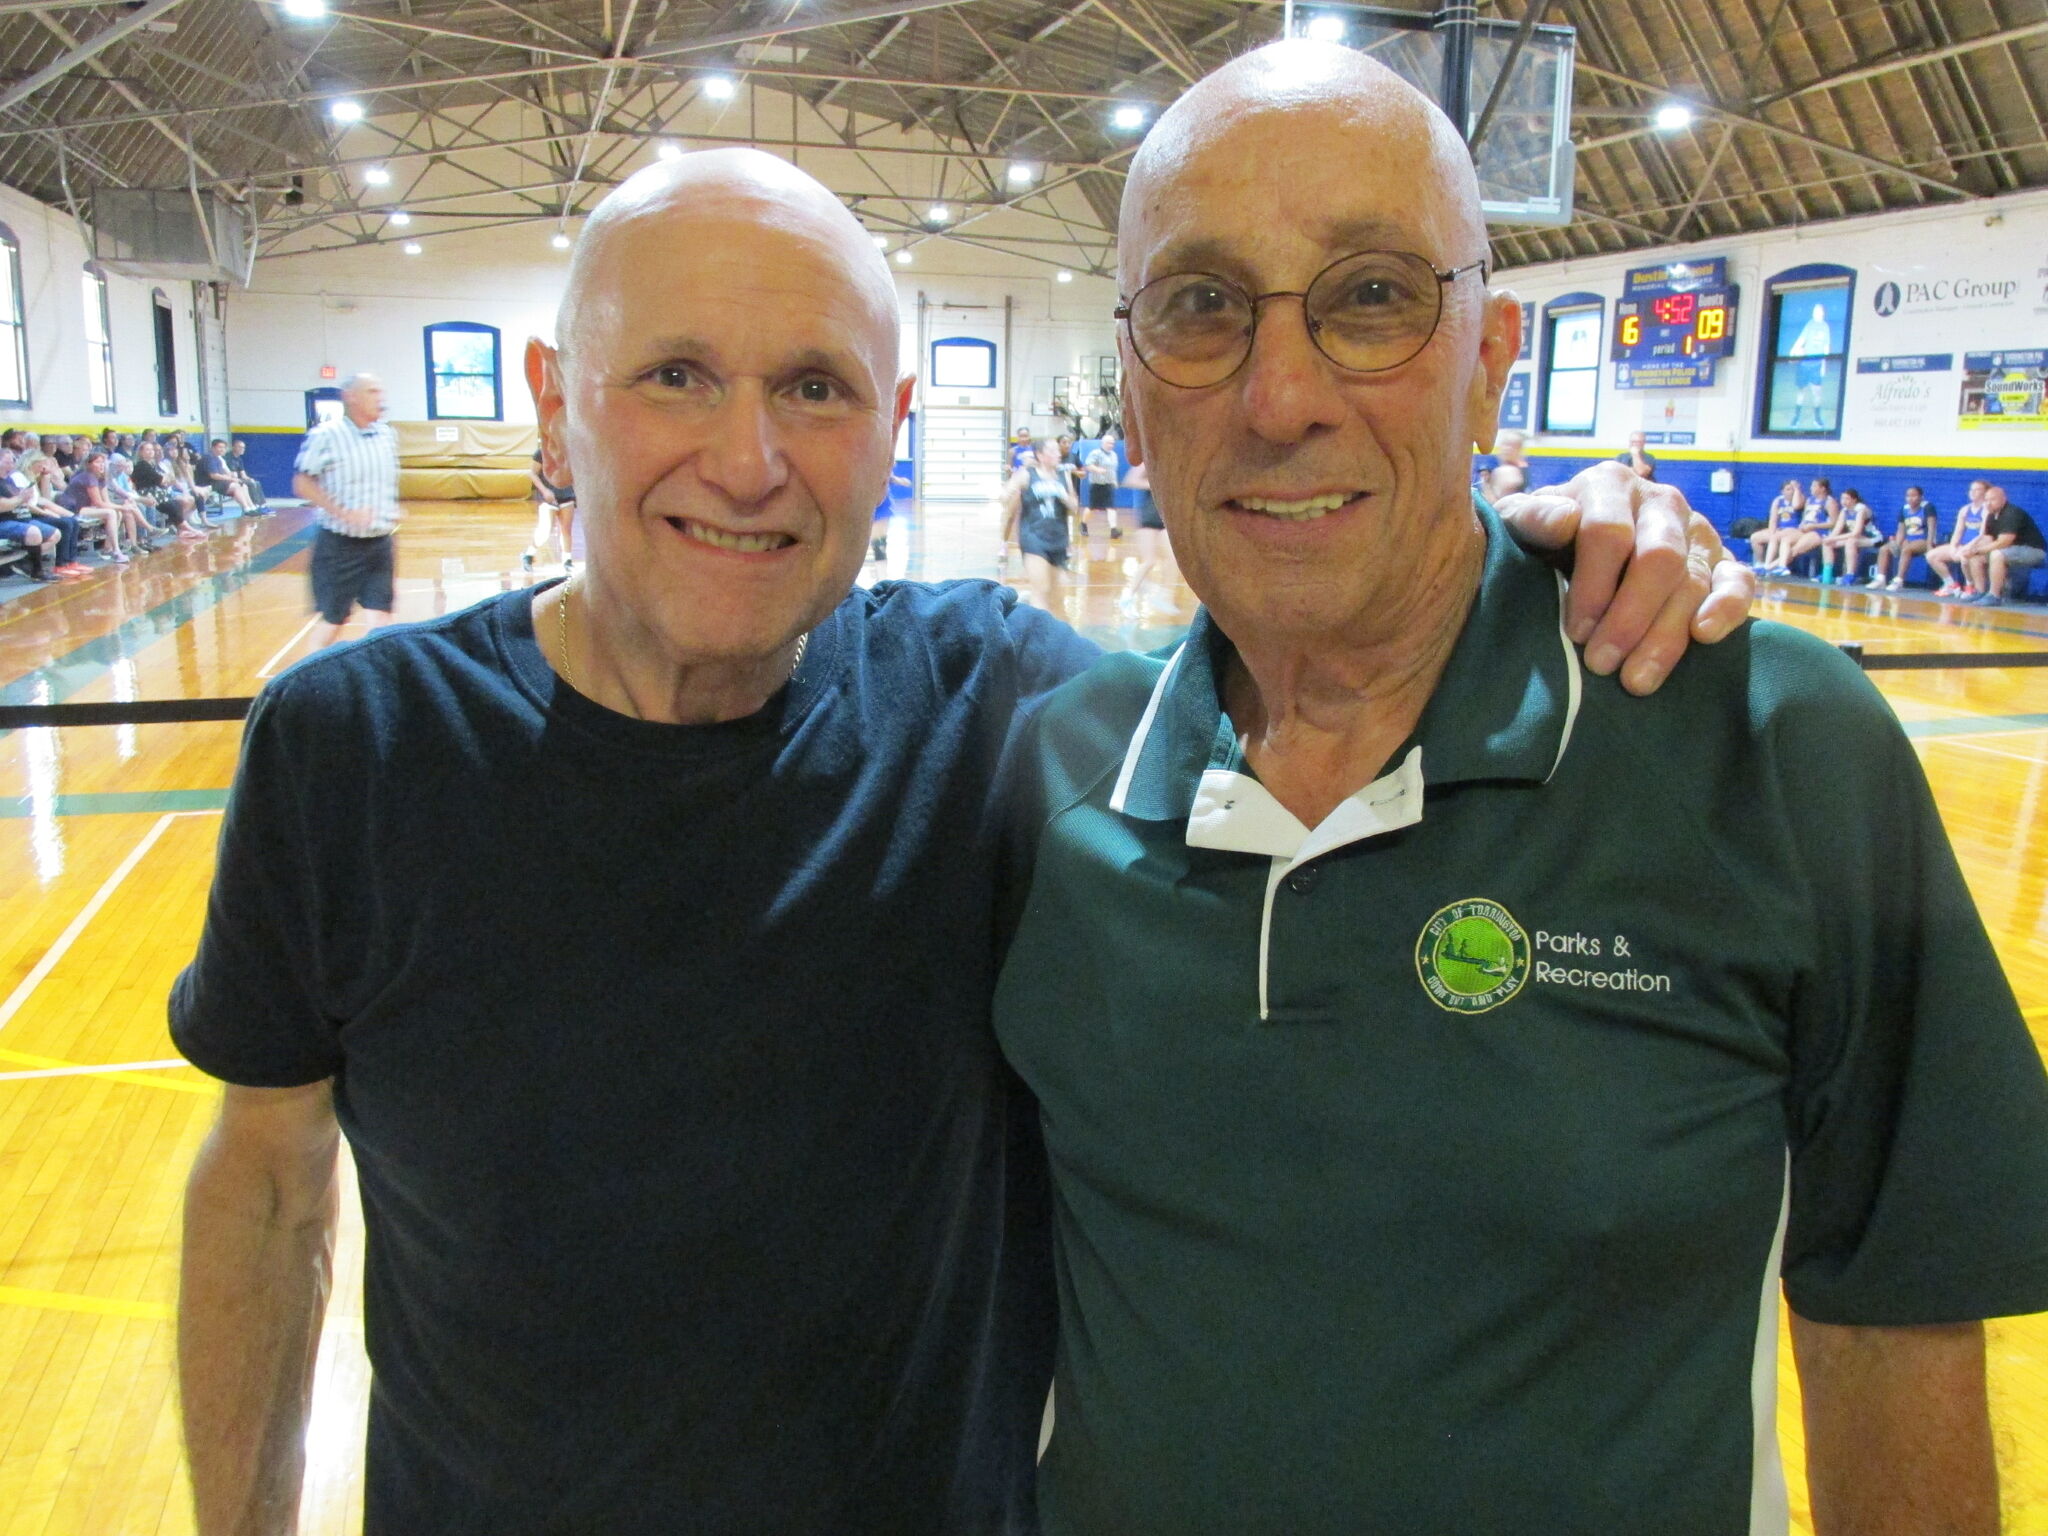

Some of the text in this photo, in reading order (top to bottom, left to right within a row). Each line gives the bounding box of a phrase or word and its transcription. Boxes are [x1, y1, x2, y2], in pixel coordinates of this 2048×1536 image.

[1906, 277, 2017, 303] PAC Group
[1655, 294, 1694, 324] 4:52
[1697, 308, 1725, 340] 09
[1871, 382, 1931, 404] Alfredo's
[1985, 380, 2044, 395] SoundWorks
[1429, 905, 1522, 941] CITY OF TORRINGTON
[1535, 931, 1631, 957] Parks &
[1427, 976, 1448, 998] COME
[1471, 994, 1493, 1006] AND
[1496, 976, 1520, 997] PLAY
[1535, 961, 1671, 992] Recreation
